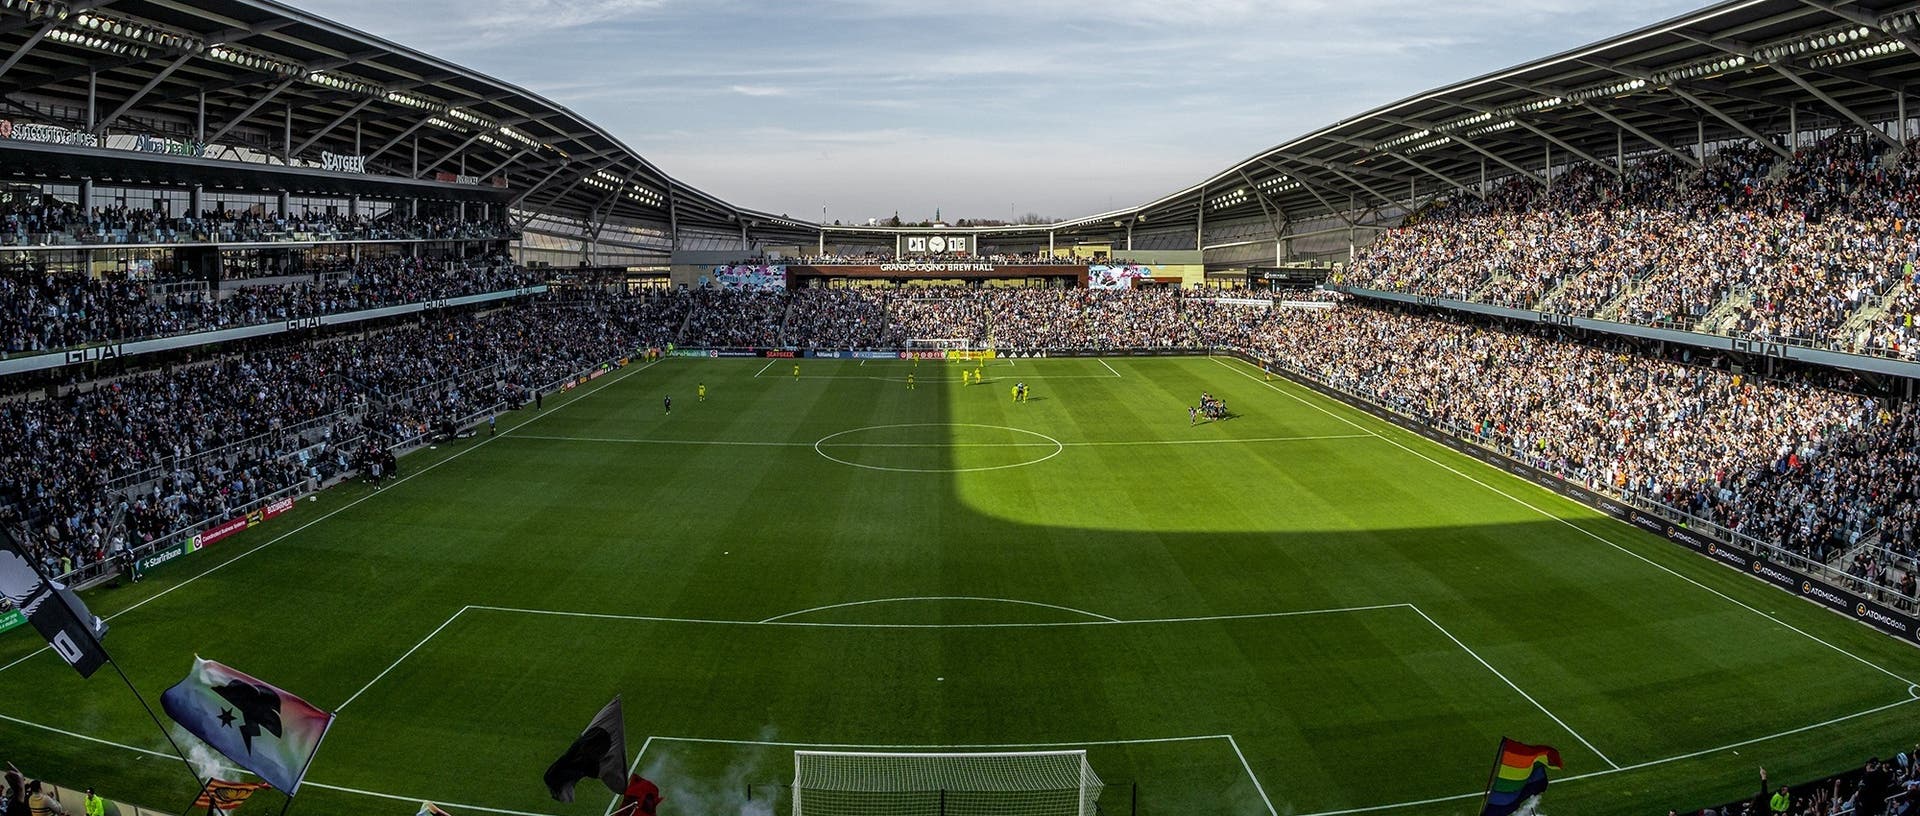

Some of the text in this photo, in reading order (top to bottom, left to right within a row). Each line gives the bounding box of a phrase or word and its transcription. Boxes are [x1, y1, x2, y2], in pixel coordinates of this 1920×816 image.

[321, 150, 366, 174] SEATGEEK
[917, 263, 945, 272] CASINO
[973, 263, 994, 271] HALL
[1715, 547, 1746, 566] ATOMICdata
[1760, 566, 1794, 585] ATOMICdata
[1810, 587, 1848, 608] ATOMICdata
[1865, 609, 1907, 632] ATOMICdata
